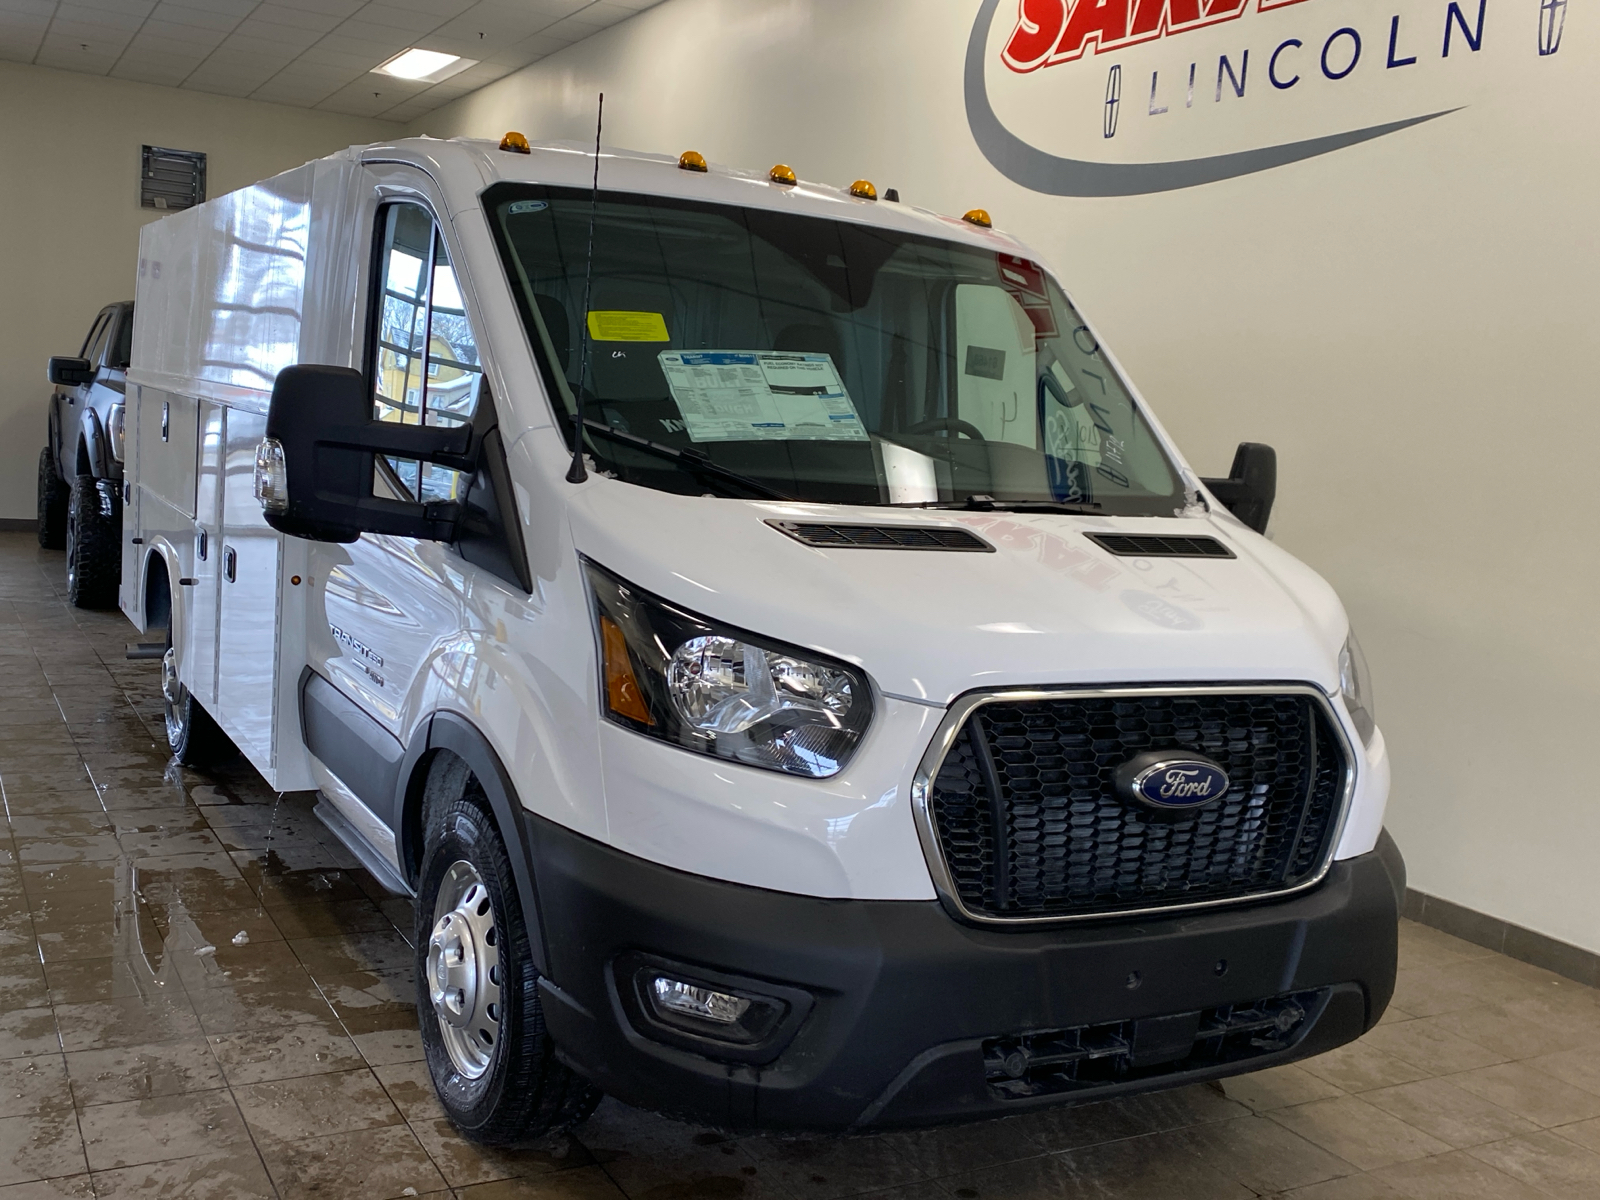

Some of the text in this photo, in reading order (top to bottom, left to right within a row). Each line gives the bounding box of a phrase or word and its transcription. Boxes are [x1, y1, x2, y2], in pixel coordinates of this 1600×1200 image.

[1148, 0, 1487, 116] LINCOLN
[329, 622, 372, 658] TRANSIT
[1160, 768, 1212, 799] Ford
